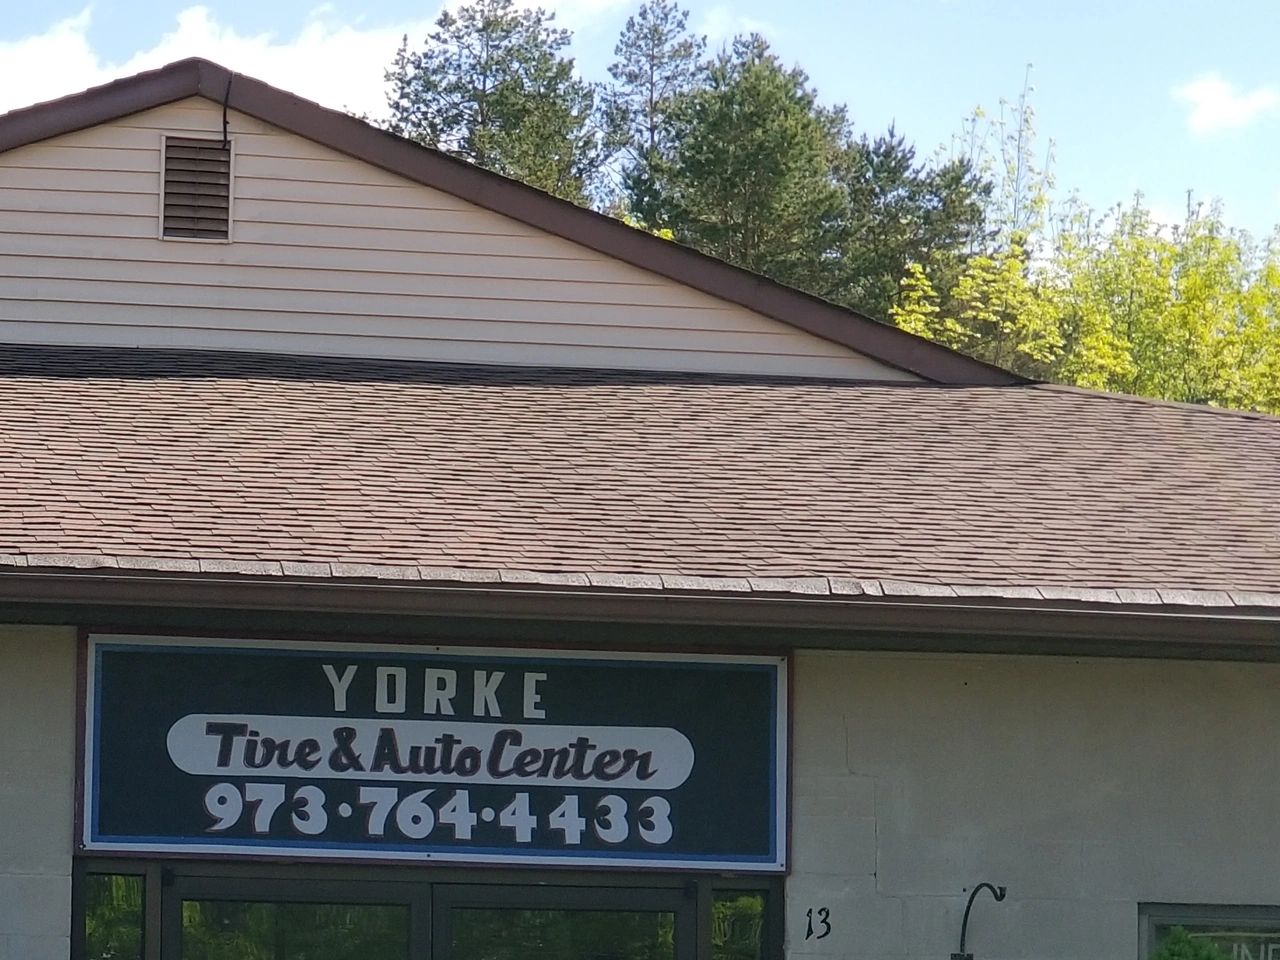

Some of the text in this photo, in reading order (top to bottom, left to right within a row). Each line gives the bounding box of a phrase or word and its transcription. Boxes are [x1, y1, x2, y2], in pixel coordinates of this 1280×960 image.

[322, 664, 547, 718] YORKE
[205, 722, 658, 781] Tire & Auto Center
[805, 907, 831, 940] 13
